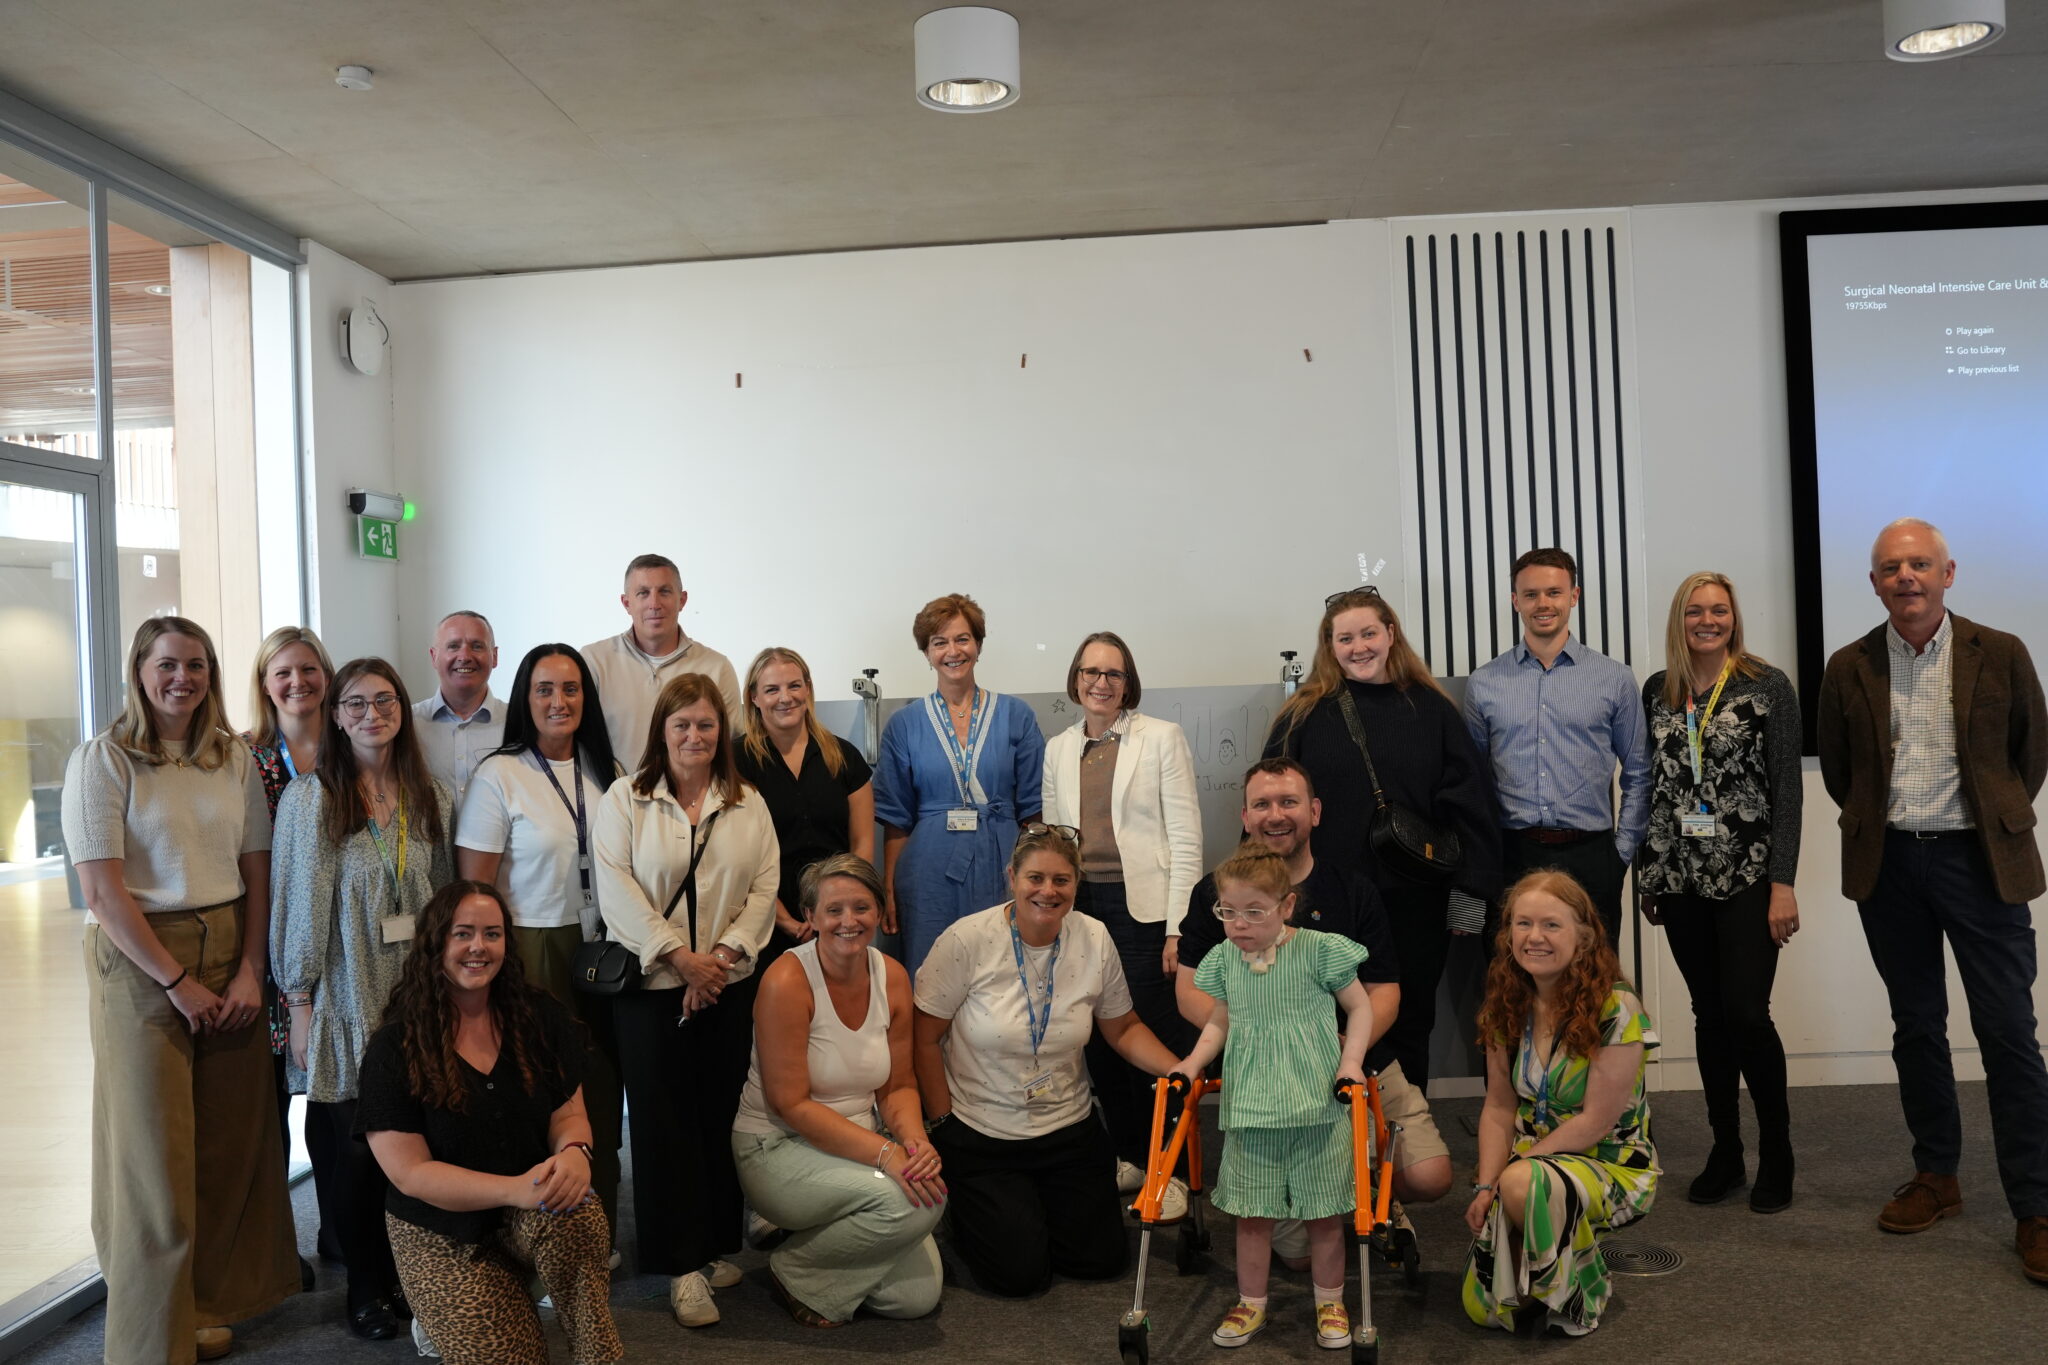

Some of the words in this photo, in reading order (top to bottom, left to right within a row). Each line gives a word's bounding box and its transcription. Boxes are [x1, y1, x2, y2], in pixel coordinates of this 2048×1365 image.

[1844, 284, 1885, 299] Surgical
[1889, 282, 1936, 295] Neonatal
[1939, 280, 1985, 293] Intensive
[1988, 280, 2012, 291] Care
[2015, 278, 2037, 290] Unit
[1845, 301, 1887, 311] 19755Kbps
[1956, 326, 1972, 336] Play
[1973, 326, 1994, 336] again
[1957, 346, 1968, 355] Go
[1970, 346, 1979, 354] to
[1980, 345, 2006, 356] Library
[1958, 366, 1973, 376] Play
[1975, 365, 2007, 376] previous
[2008, 364, 2019, 373] list
